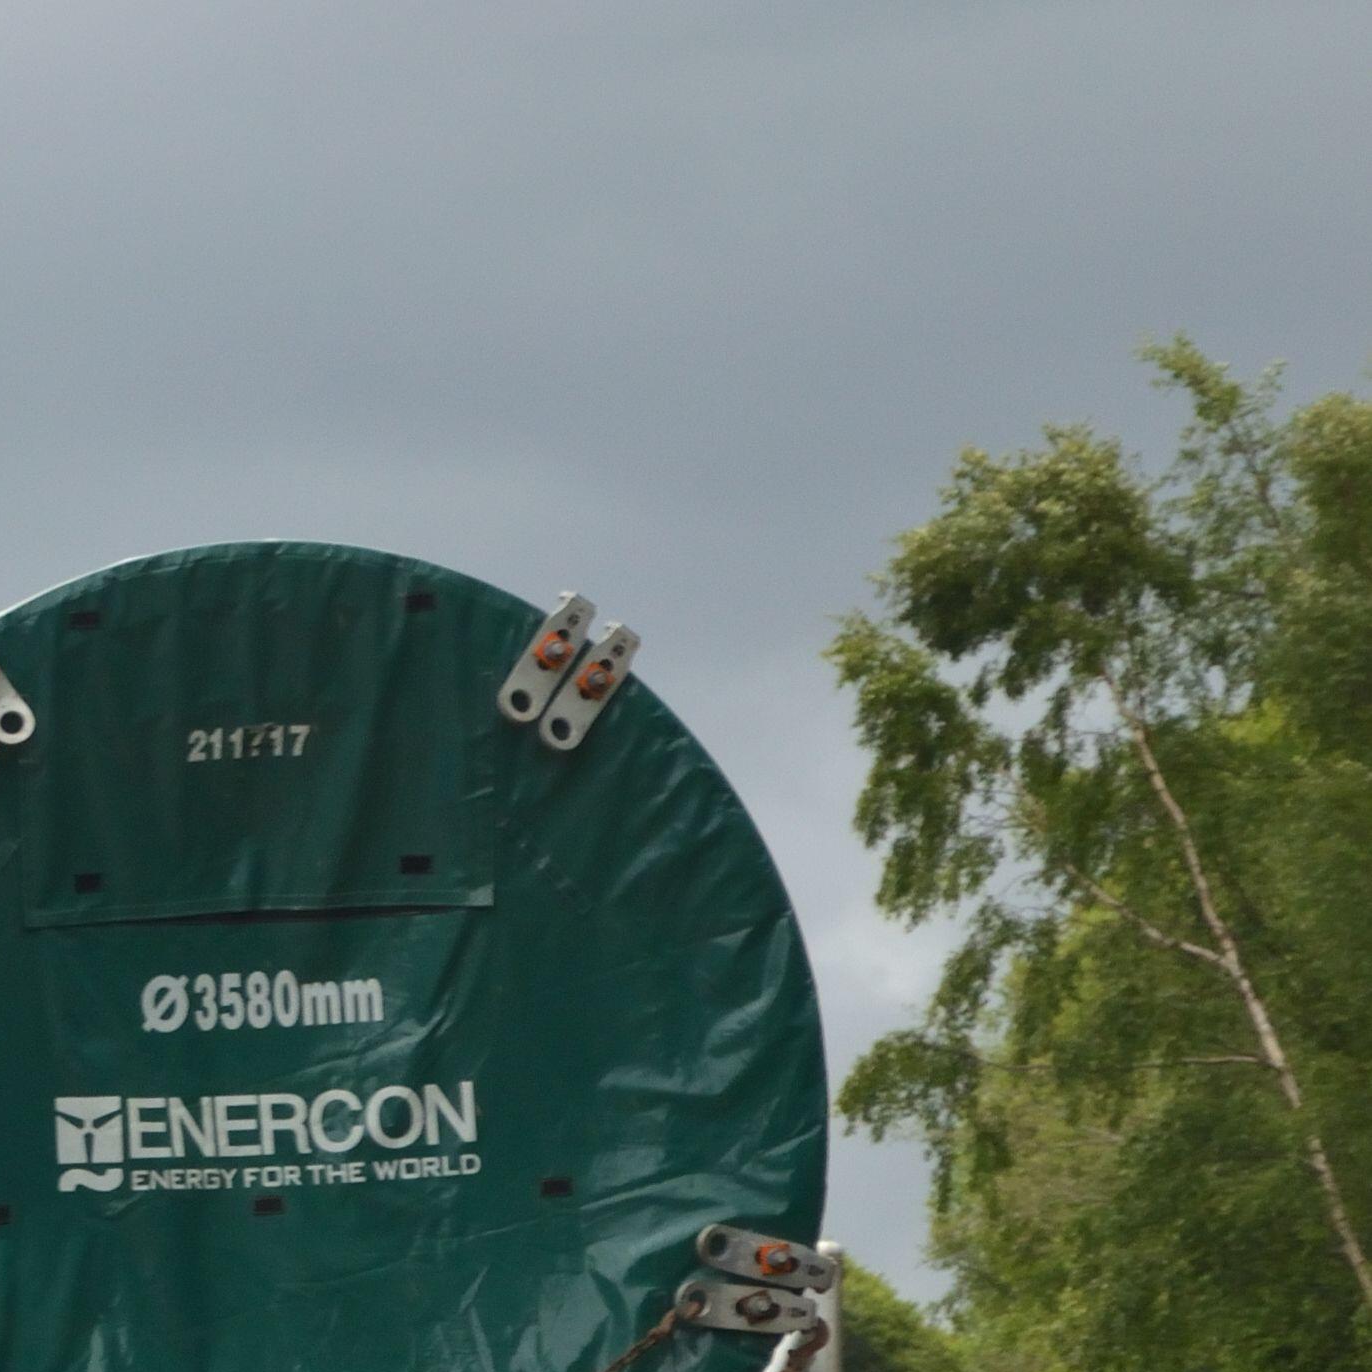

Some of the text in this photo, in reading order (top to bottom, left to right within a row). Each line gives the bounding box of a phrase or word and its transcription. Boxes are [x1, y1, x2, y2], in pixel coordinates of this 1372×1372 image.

[126, 1081, 478, 1159] ENERCON
[130, 1153, 482, 1191] ENERGY FOR THE WORLD
